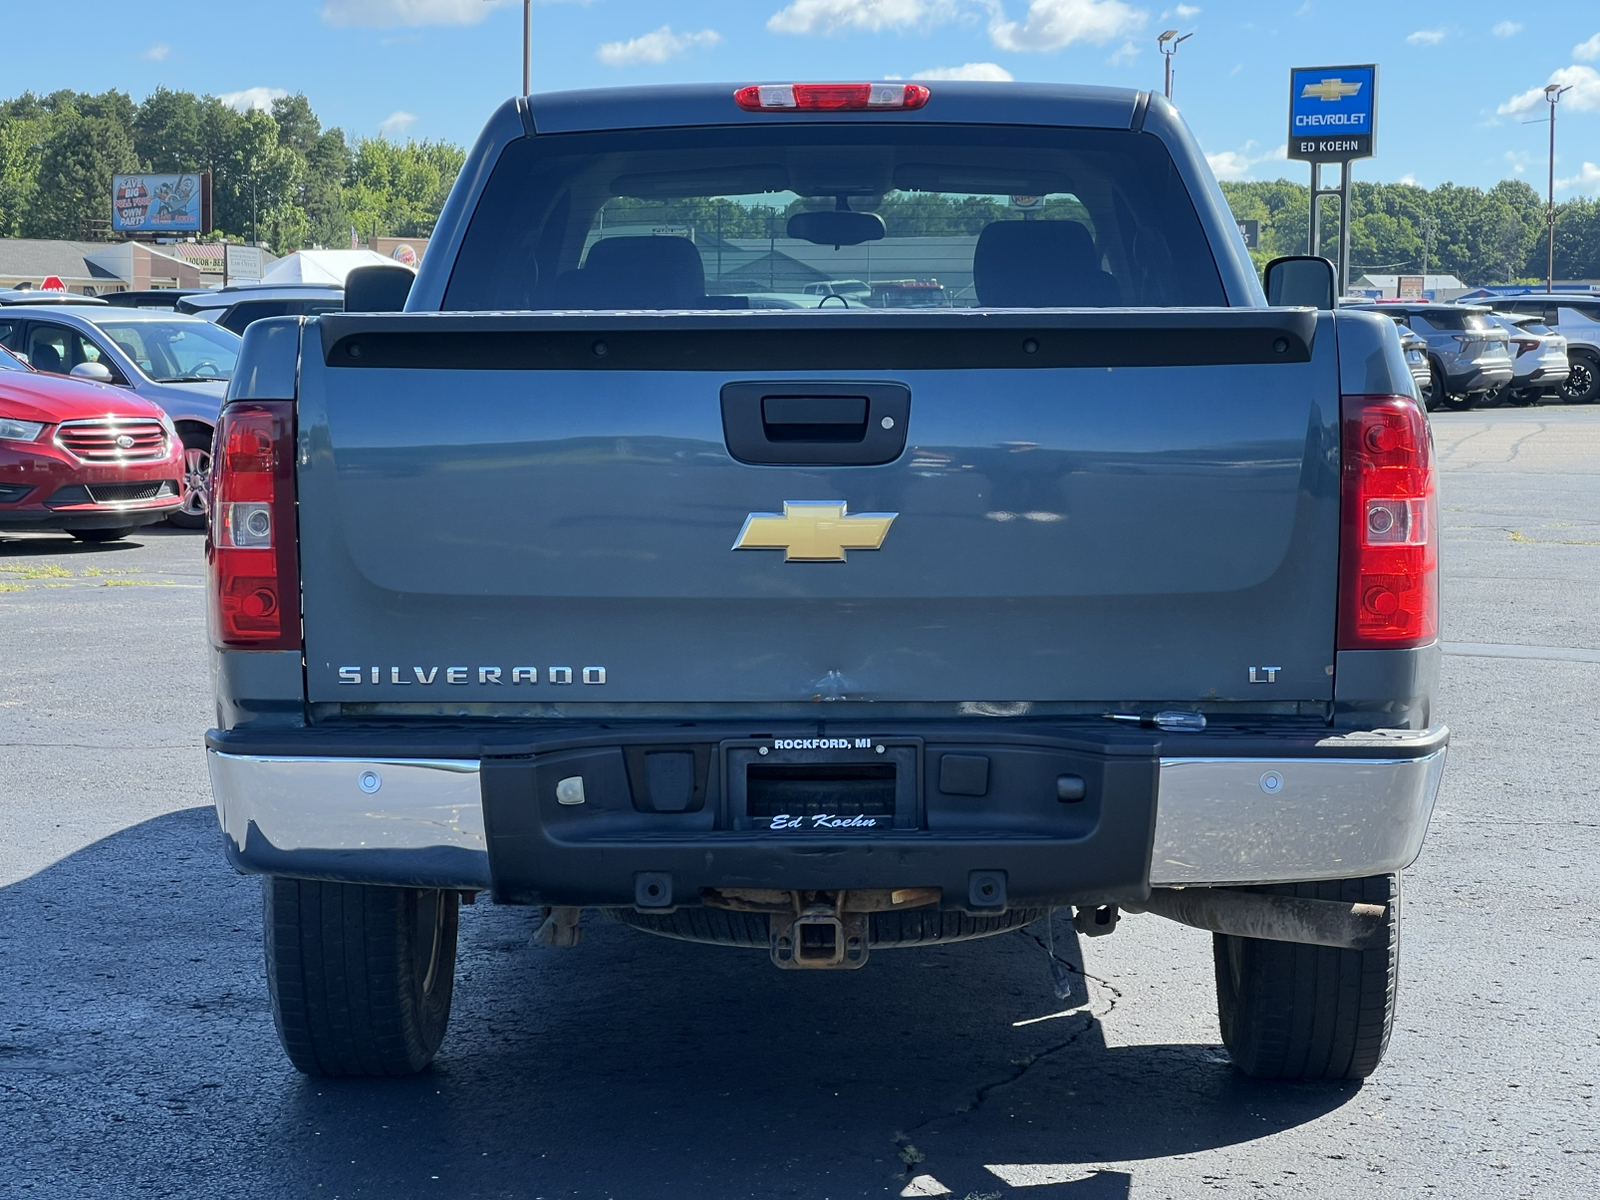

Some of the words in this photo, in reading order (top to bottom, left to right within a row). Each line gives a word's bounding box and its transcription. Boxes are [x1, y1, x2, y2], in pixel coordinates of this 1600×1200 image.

[1296, 113, 1366, 126] CHEVROLET
[1301, 142, 1315, 152] ED
[1320, 141, 1358, 152] KOEHN
[121, 179, 143, 189] SAVE
[125, 188, 139, 198] BIG
[116, 199, 132, 208] PULL
[133, 197, 152, 206] YOUR
[123, 208, 142, 218] OWN
[120, 215, 145, 226] PARTS
[339, 667, 606, 684] SILVERADO
[1249, 666, 1282, 683] LT
[774, 739, 851, 749] ROCKFORD,
[855, 738, 871, 748] MI
[770, 814, 803, 829] Ed
[811, 814, 877, 828] Koehn
